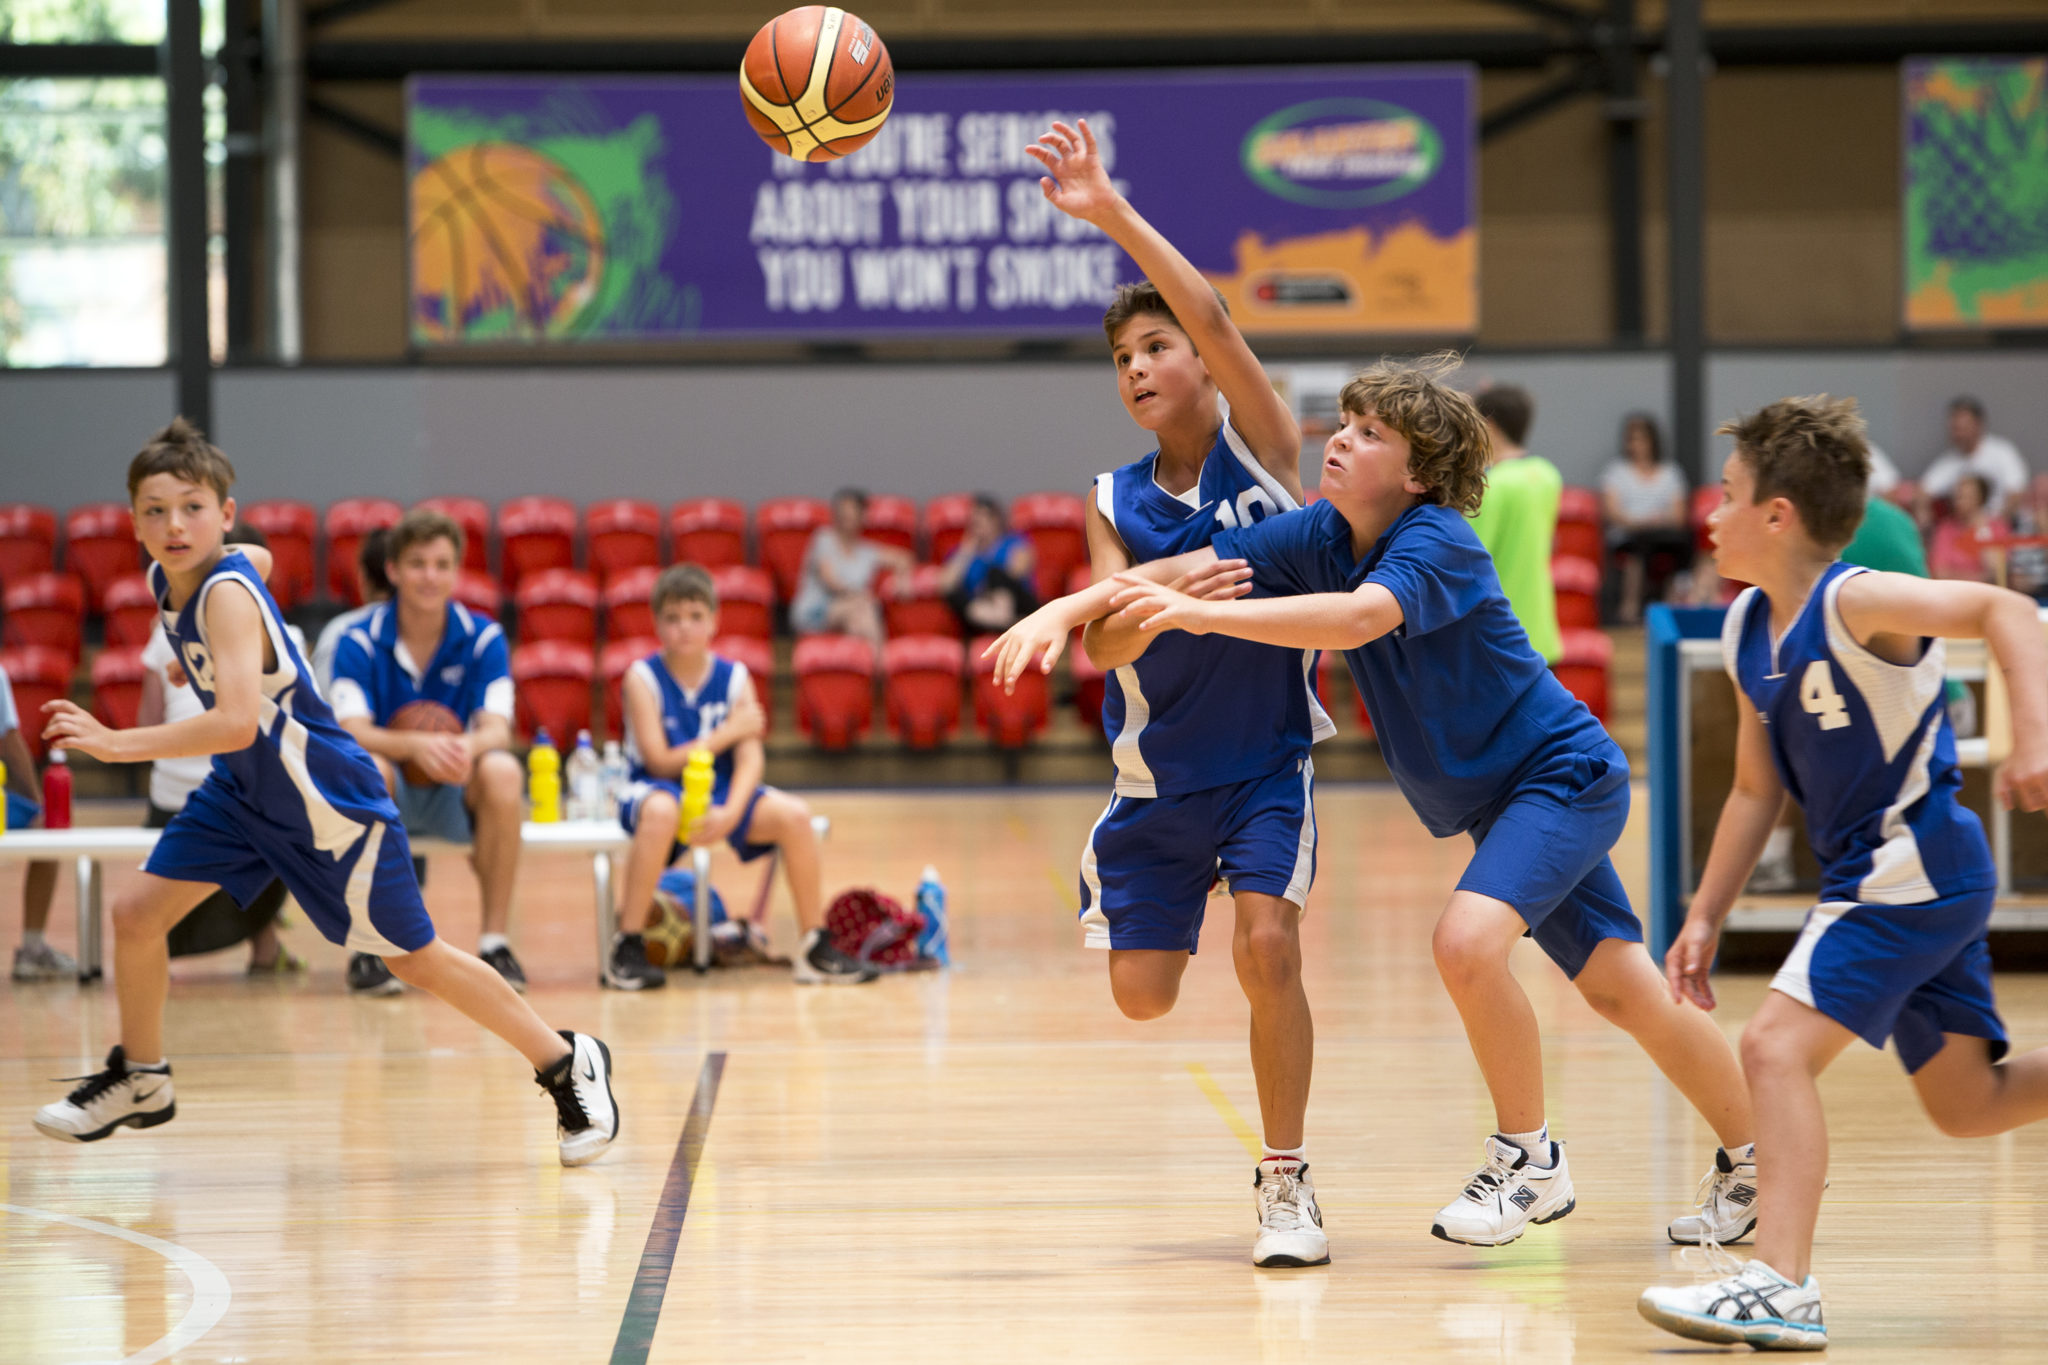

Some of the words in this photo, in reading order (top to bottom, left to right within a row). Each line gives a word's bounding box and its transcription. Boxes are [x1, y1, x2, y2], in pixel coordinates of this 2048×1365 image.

[826, 113, 951, 178] U'RE
[957, 111, 1116, 176] SERIS
[751, 180, 883, 243] ABOUT
[891, 179, 999, 243] YOUR
[758, 248, 844, 311] YOU
[851, 247, 979, 311] WON'T
[987, 245, 1120, 309] SMOKE
[1214, 485, 1279, 530] 10
[1800, 660, 1851, 730] 4
